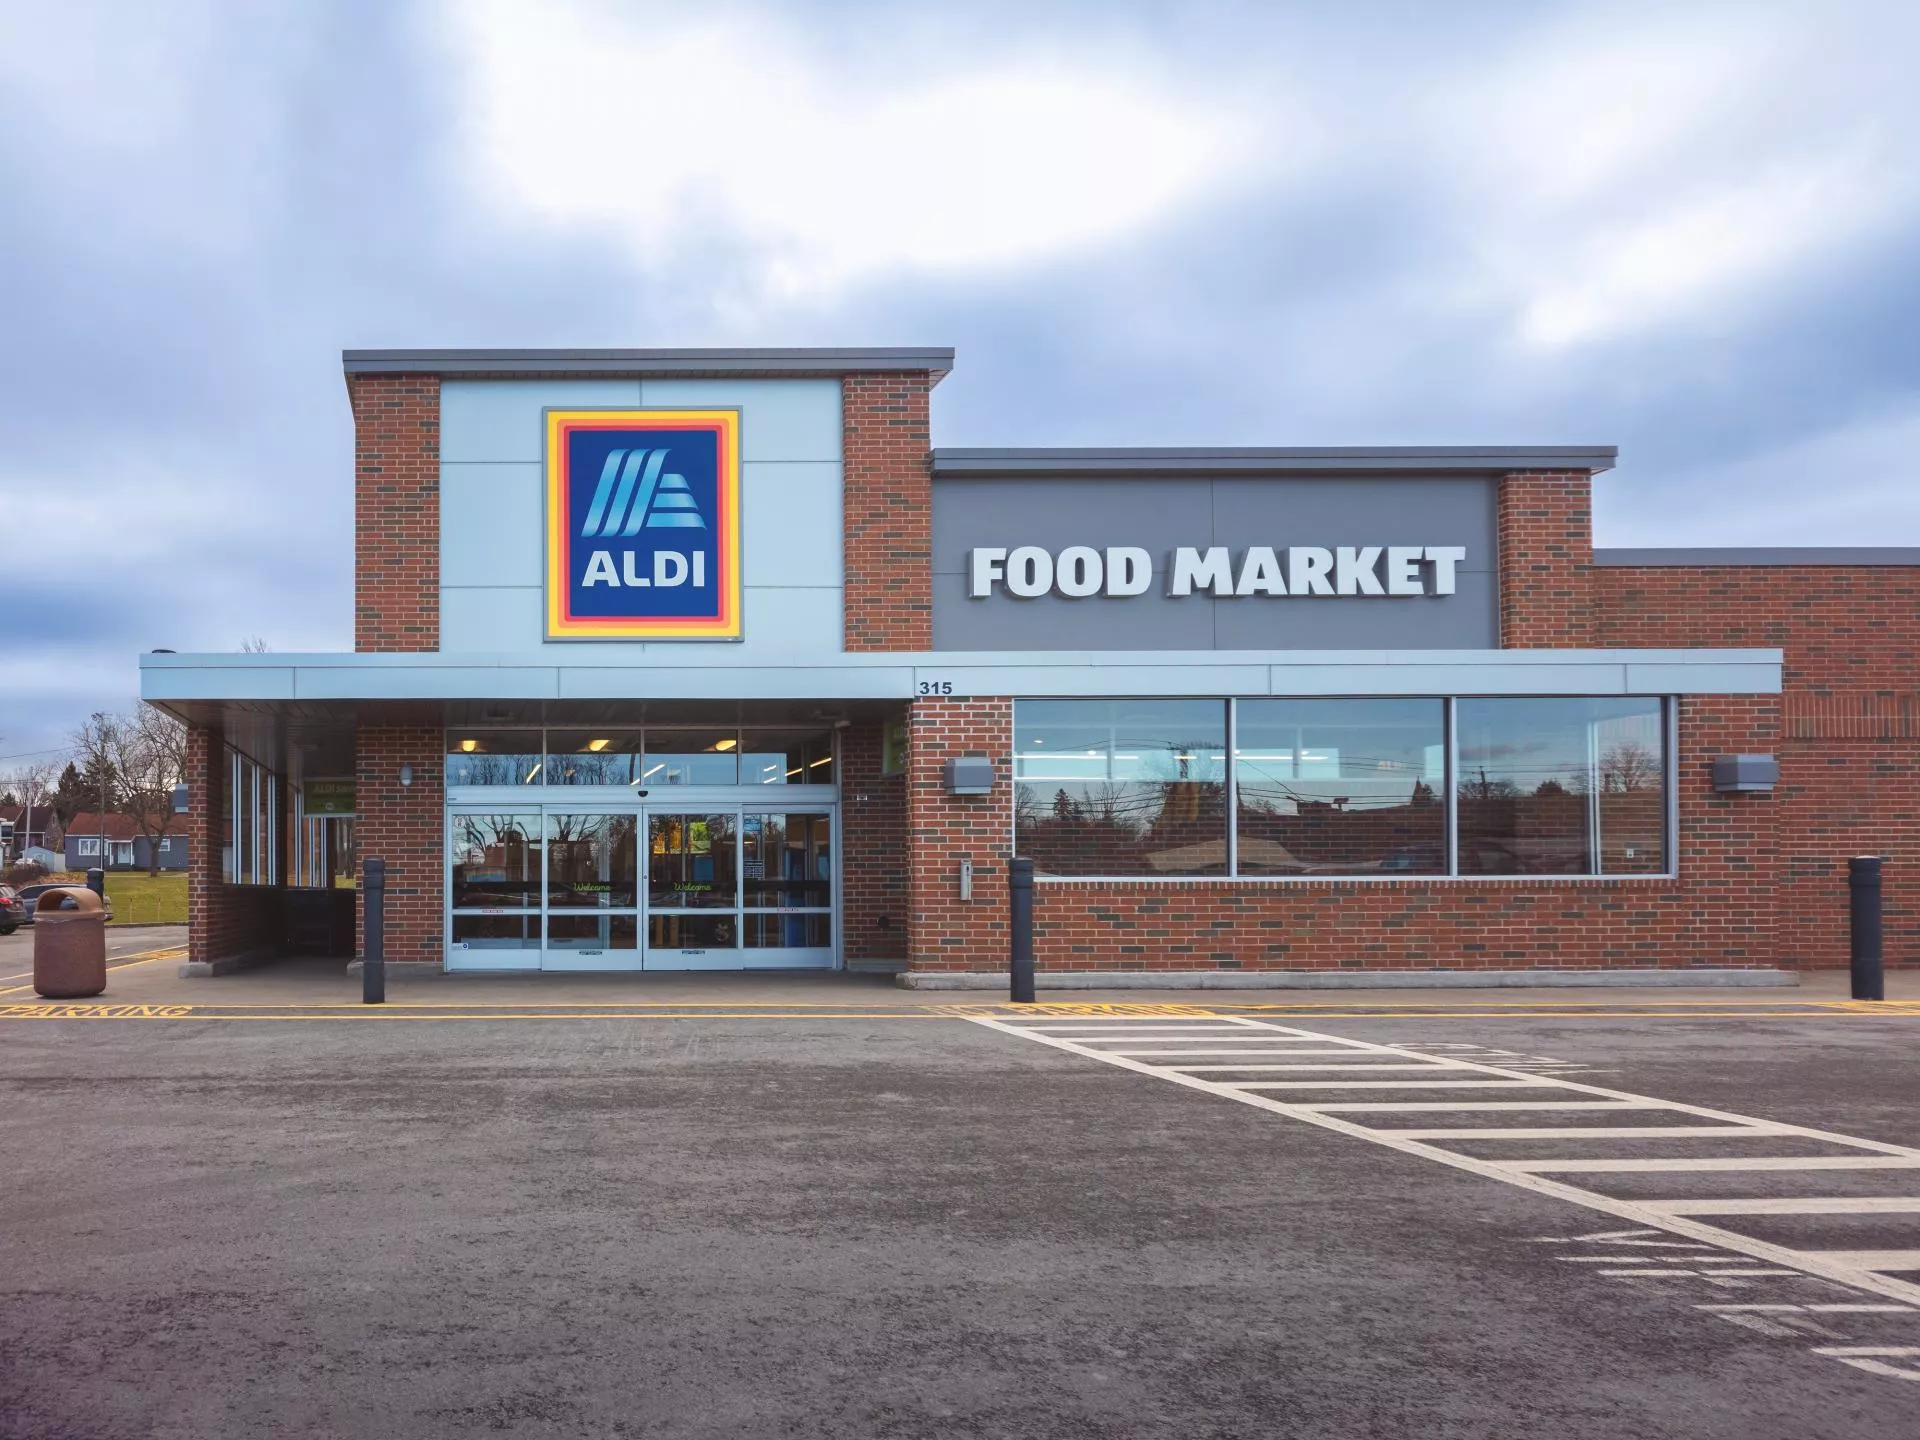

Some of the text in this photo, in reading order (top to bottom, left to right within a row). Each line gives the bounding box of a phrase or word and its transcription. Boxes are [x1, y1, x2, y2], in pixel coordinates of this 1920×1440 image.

[581, 550, 705, 587] ALDI
[970, 545, 1466, 597] FOOD MARKET
[919, 681, 952, 695] 315
[573, 881, 611, 892] Welcome
[674, 881, 712, 892] Welcome
